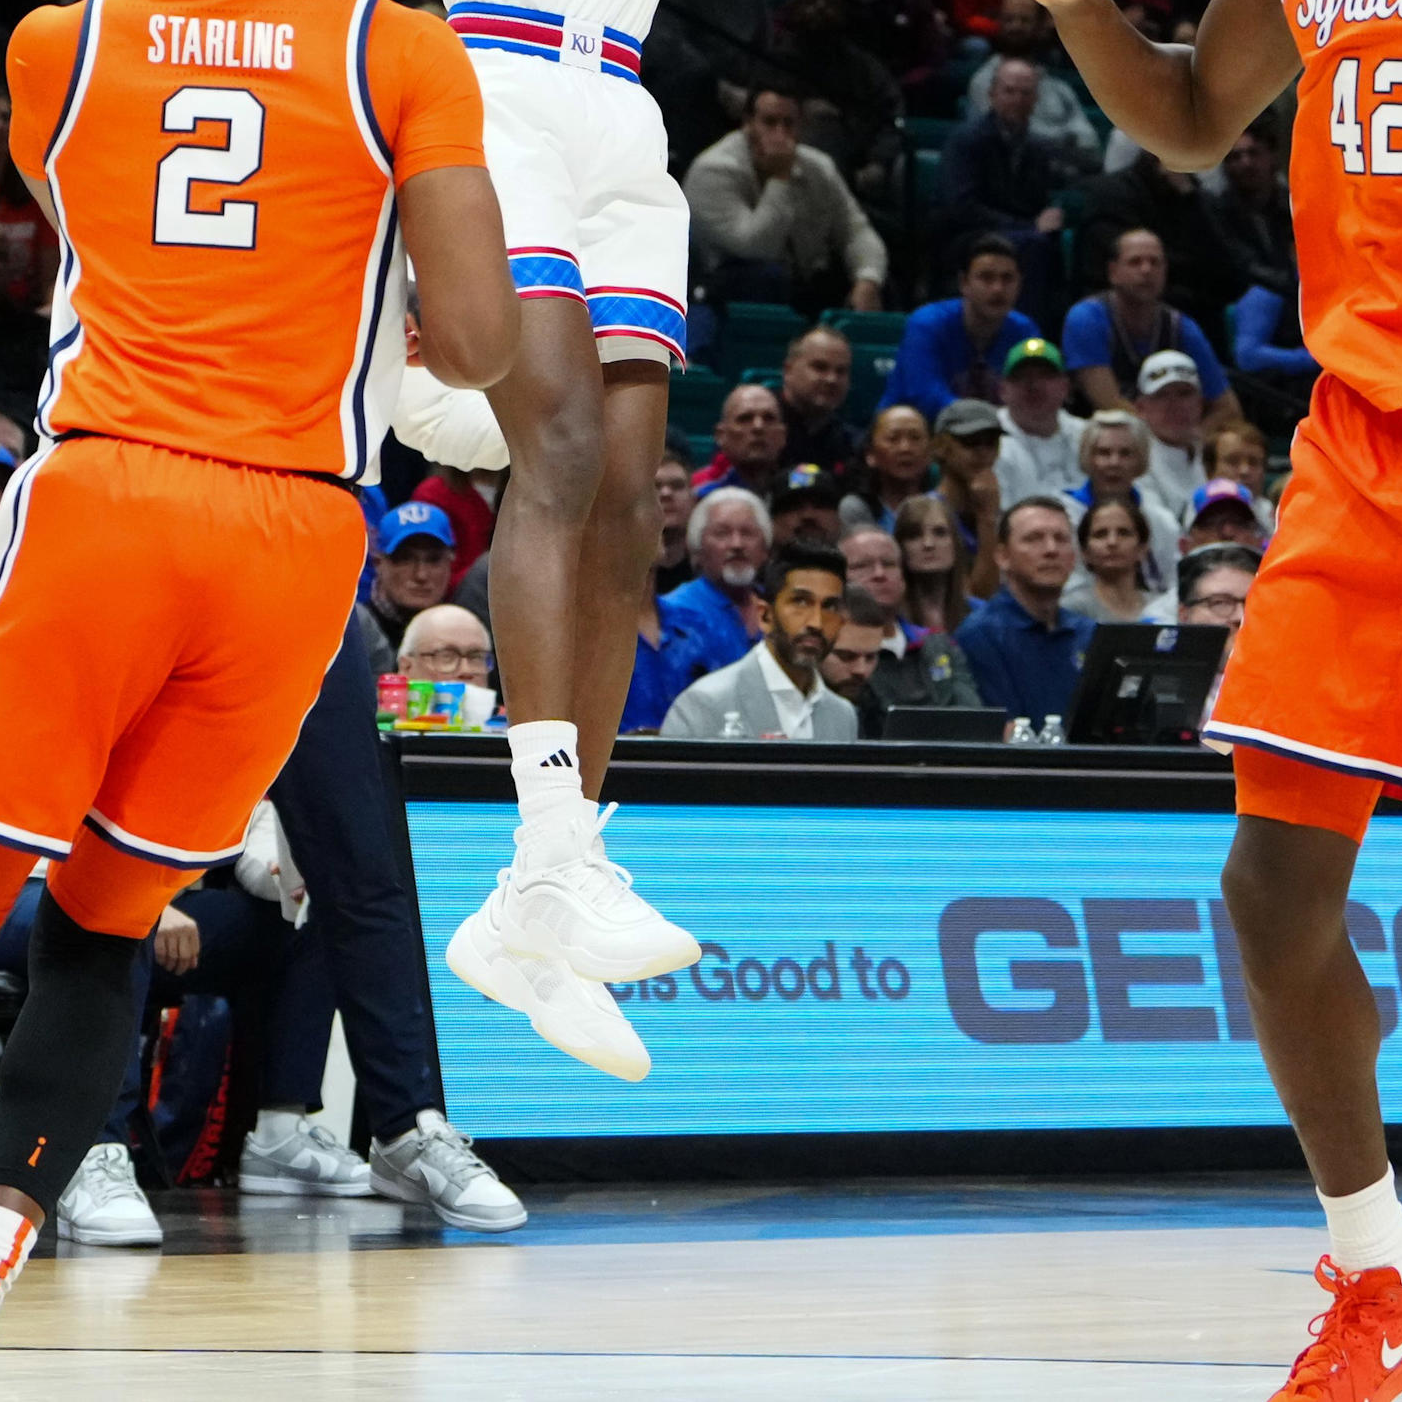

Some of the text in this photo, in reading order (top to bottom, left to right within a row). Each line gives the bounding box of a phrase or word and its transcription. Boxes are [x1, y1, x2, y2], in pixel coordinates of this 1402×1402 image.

[148, 14, 295, 71] STARLING
[570, 32, 596, 55] KU
[152, 85, 267, 251] 2
[690, 940, 844, 1001] Good
[848, 947, 911, 1001] to
